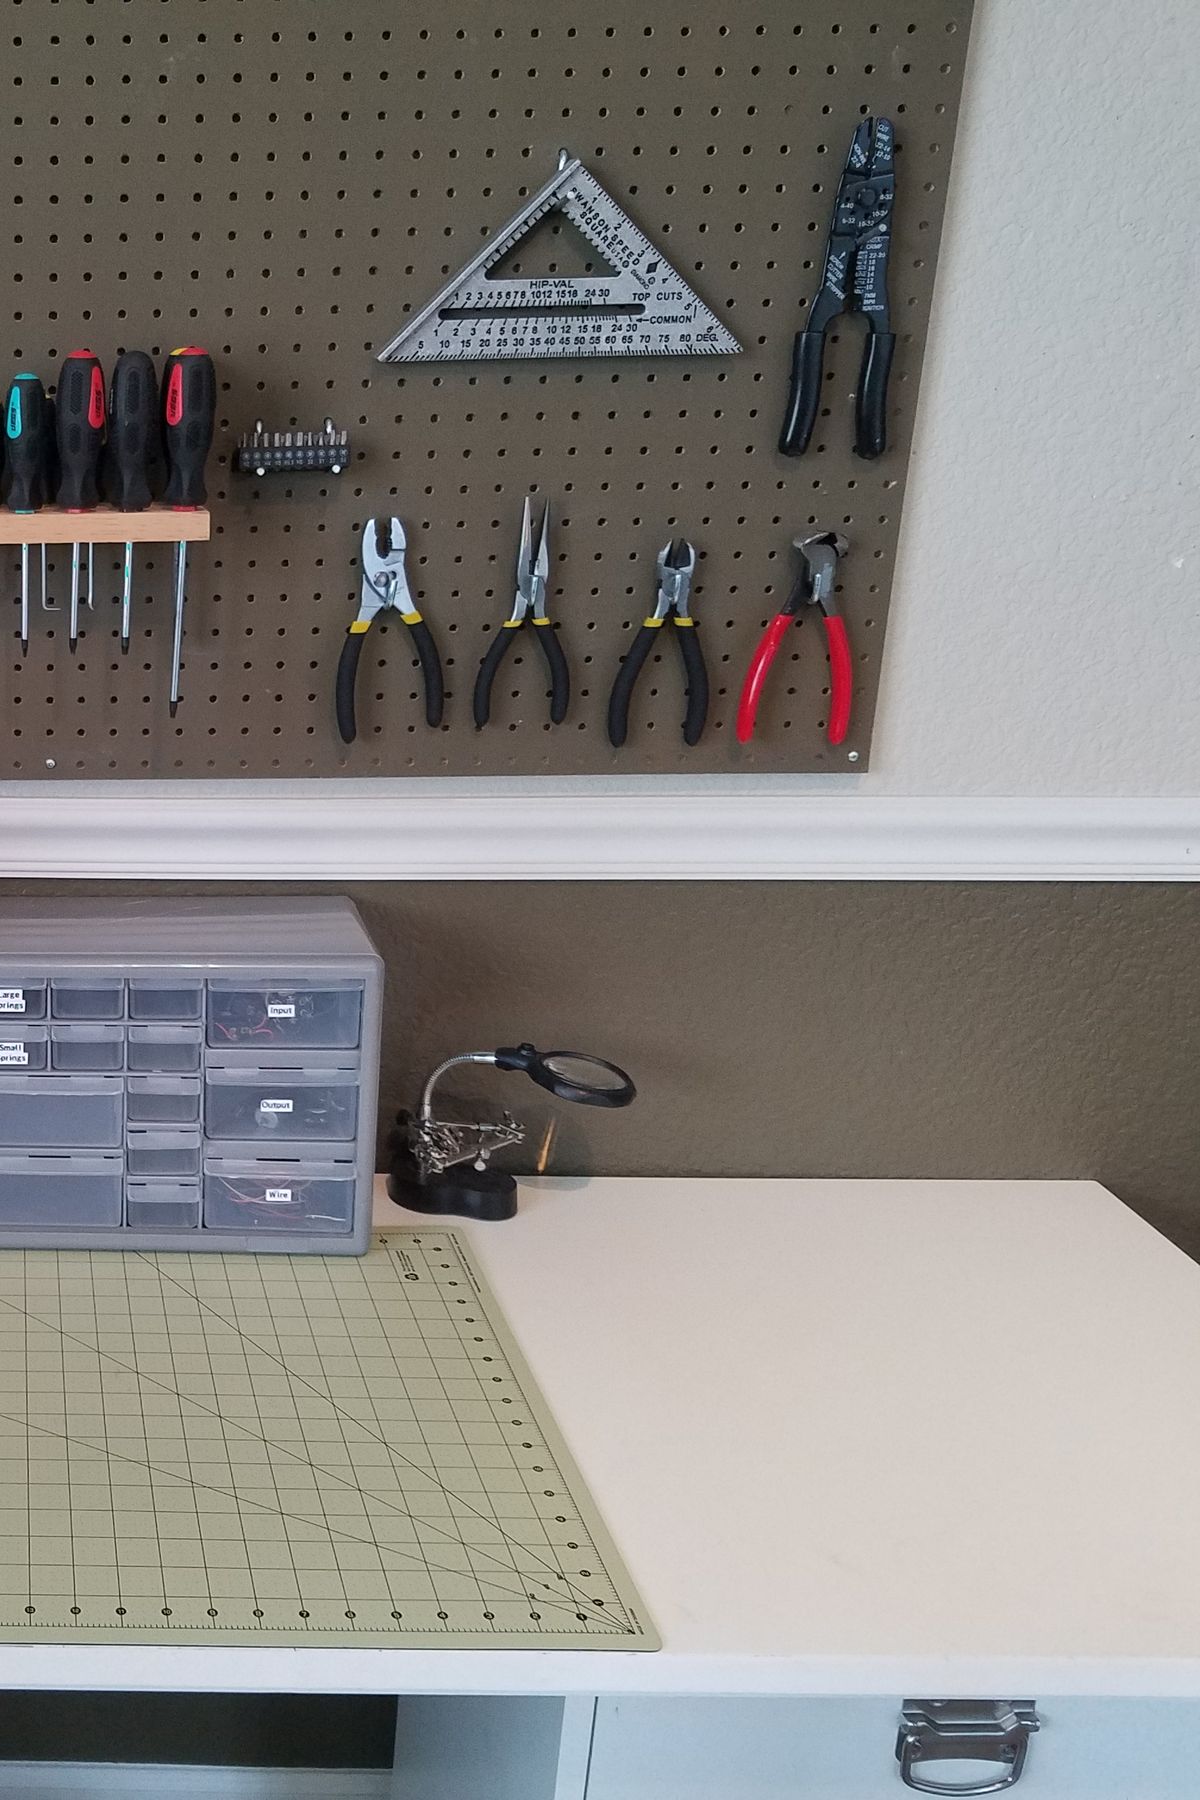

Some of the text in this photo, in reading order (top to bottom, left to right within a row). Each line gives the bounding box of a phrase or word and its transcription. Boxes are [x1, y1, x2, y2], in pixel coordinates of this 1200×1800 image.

[570, 187, 640, 266] SWANSON SPEED
[580, 212, 615, 249] SQUARE
[529, 280, 575, 289] HIP-VAL
[454, 288, 610, 301] 1 2 3 4 5 6 7 8 10 12 15 18 24 30
[632, 291, 683, 301] TOP CUTS
[650, 314, 692, 325] COMMON
[433, 323, 638, 337] 1 2 3 4 5 6 7 8 10 12 15 18 24 30
[418, 333, 719, 349] 5 10 15 20 25 30 35 40 45 50 55 60 65 70 75 80 DEG.
[270, 1006, 293, 1015] Input
[0, 1044, 22, 1052] Small
[262, 1102, 291, 1110] Output
[269, 1191, 288, 1199] Wire
